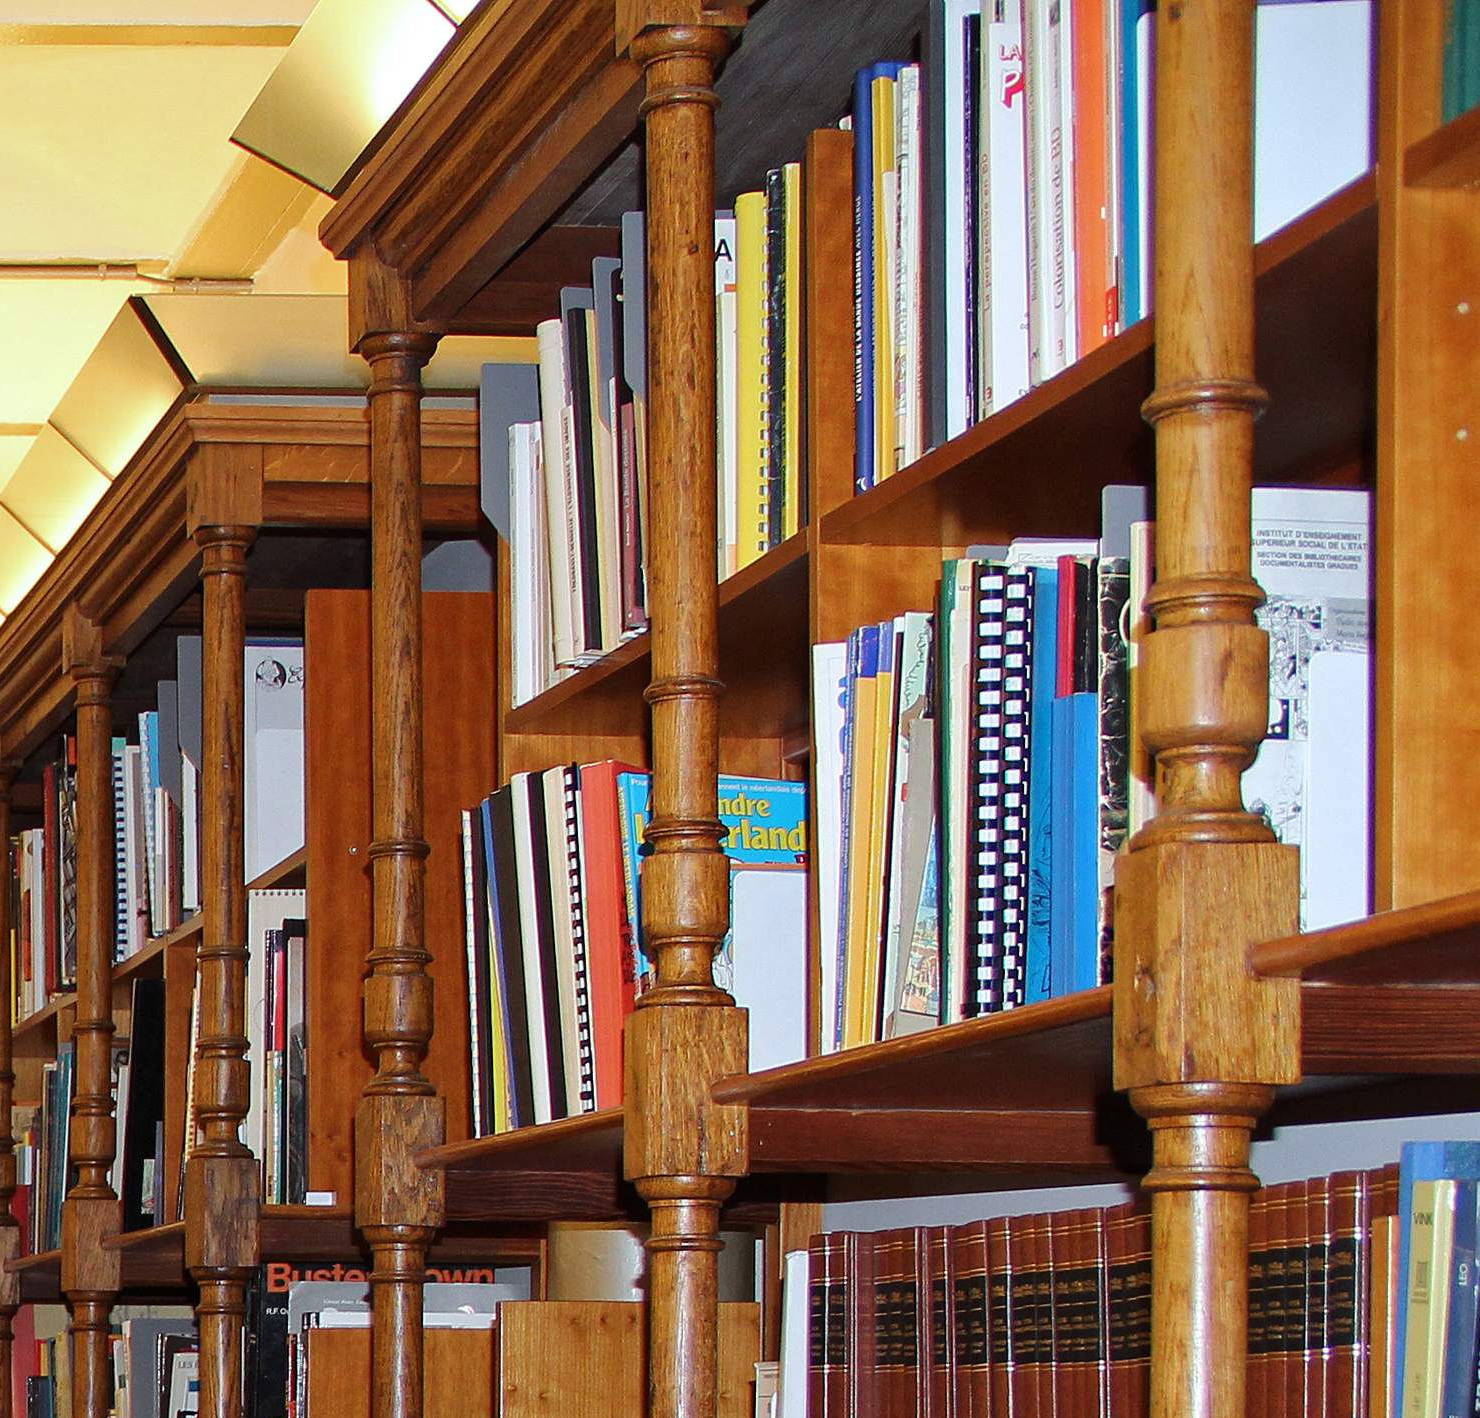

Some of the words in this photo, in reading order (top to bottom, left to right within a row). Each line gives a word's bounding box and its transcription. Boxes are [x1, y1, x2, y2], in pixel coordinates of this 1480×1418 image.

[1048, 126, 1062, 161] BD
[1050, 164, 1063, 188] de
[1050, 191, 1065, 310] Colorisation
[1413, 1212, 1433, 1227] VINK
[1458, 1263, 1470, 1287] LEO
